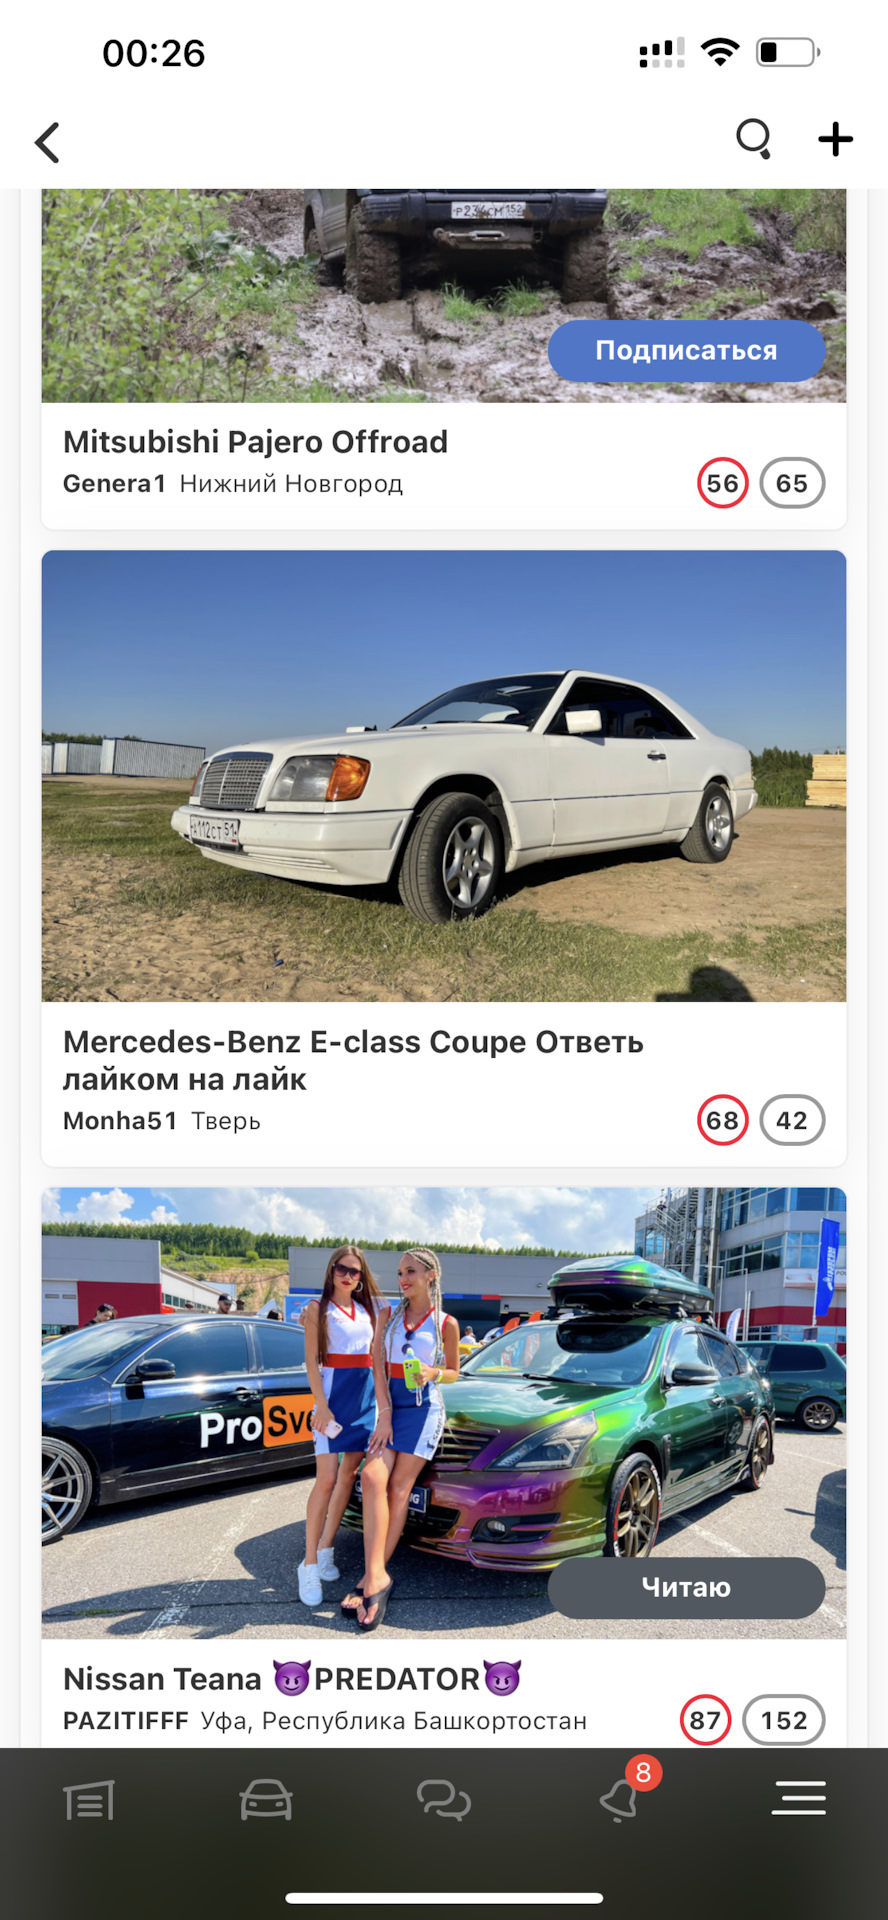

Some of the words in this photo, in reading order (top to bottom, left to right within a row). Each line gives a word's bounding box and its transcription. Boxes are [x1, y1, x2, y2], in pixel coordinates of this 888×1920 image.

[102, 39, 205, 68] 00:26
[505, 204, 522, 213] 152
[596, 340, 778, 364] Подписаться
[64, 428, 219, 454] Mitsubishi
[229, 428, 323, 459] Pajero
[332, 428, 448, 454] Offroad
[63, 473, 165, 493] Genera1
[181, 472, 276, 493] Нижний
[286, 474, 403, 498] Новгород
[706, 473, 739, 493] 56
[776, 473, 808, 493] 65
[224, 822, 236, 837] 51
[64, 1029, 301, 1054] Mercedes-Benz
[311, 1029, 421, 1054] E-class
[430, 1029, 526, 1060] Coupe
[536, 1029, 644, 1054] Ответь
[62, 1065, 179, 1091] лайком
[189, 1072, 224, 1091] на
[232, 1065, 307, 1091] лайк
[64, 1110, 177, 1131] Monha51
[191, 1111, 261, 1136] Тверь
[706, 1111, 739, 1131] 68
[775, 1111, 808, 1131] 42
[642, 1577, 731, 1598] Читаю
[64, 1665, 164, 1691] Nissan
[173, 1667, 261, 1691] Teana
[315, 1667, 480, 1691] PREDATOR
[64, 1711, 189, 1730] PAZITIFFF
[200, 1711, 253, 1734] Уфа,
[263, 1710, 405, 1736] Республика
[414, 1711, 587, 1735] Башкортостан
[689, 1711, 721, 1731] 87
[761, 1711, 807, 1731] 152
[636, 1761, 651, 1783] 8
